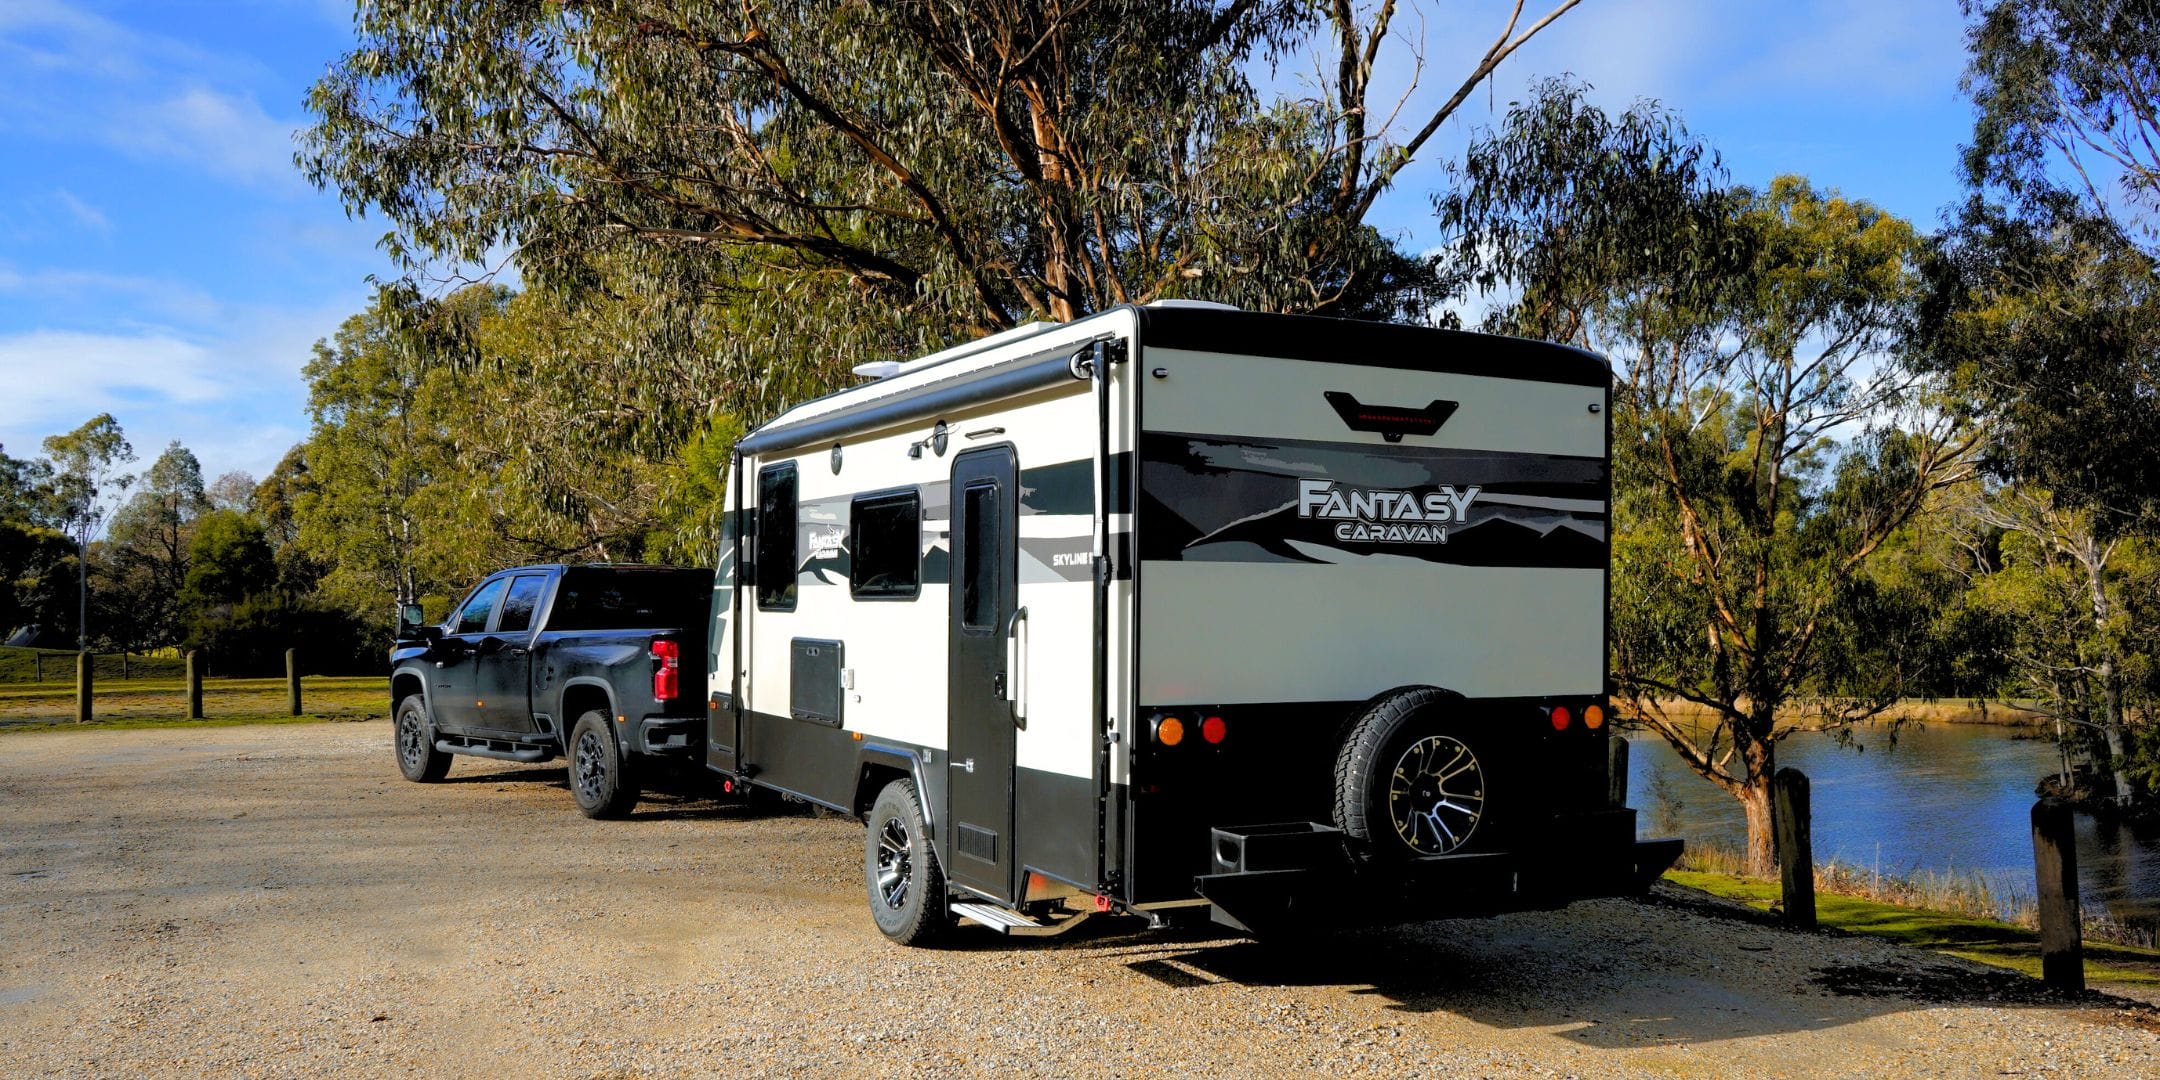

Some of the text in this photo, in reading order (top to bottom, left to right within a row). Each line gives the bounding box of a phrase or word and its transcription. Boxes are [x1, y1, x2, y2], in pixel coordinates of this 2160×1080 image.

[1298, 478, 1482, 524] FANTASY
[1335, 522, 1449, 545] CARAVAN
[1053, 552, 1088, 566] SKYLINE
